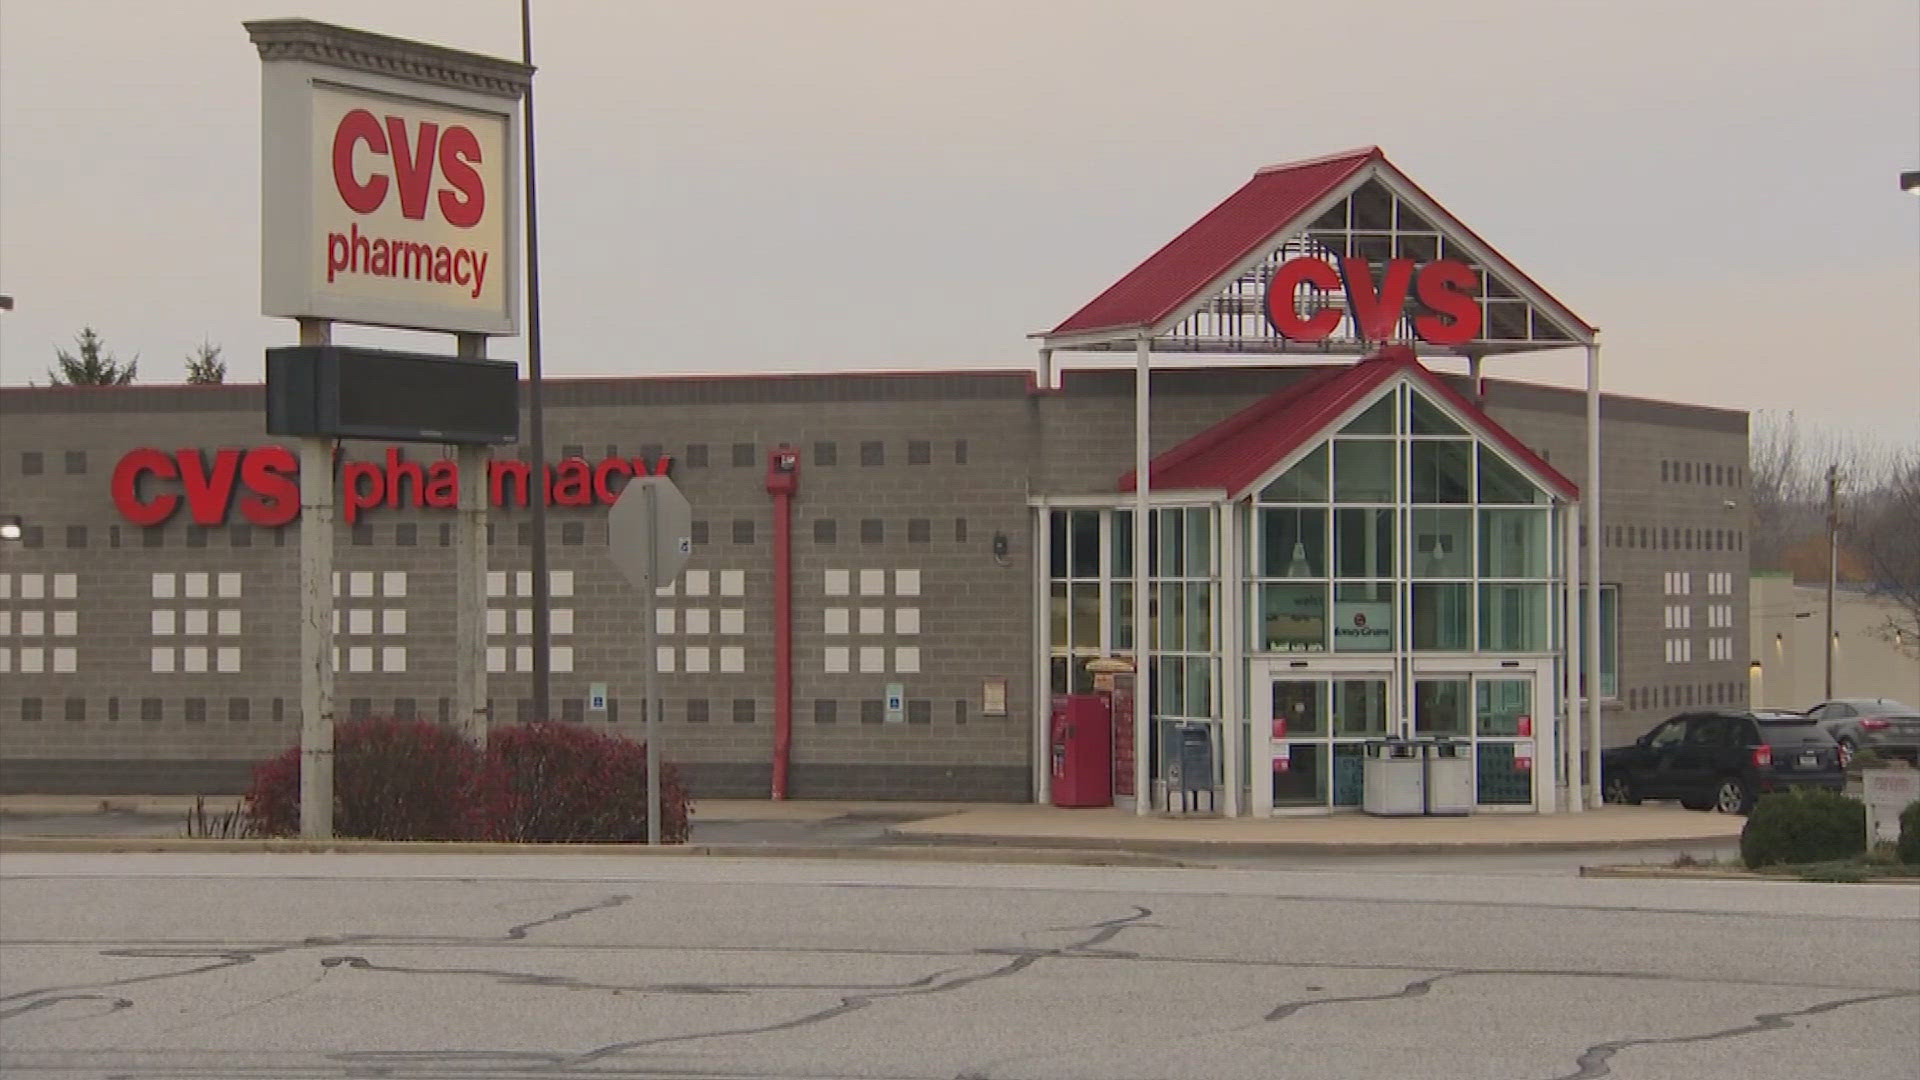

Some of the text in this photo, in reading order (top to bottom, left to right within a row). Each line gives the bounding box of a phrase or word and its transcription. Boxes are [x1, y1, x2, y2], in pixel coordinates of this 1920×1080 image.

[332, 108, 486, 229] CVS
[327, 222, 488, 299] pharmacy
[1268, 255, 1482, 345] CVS
[111, 445, 671, 527] CVS phamac
